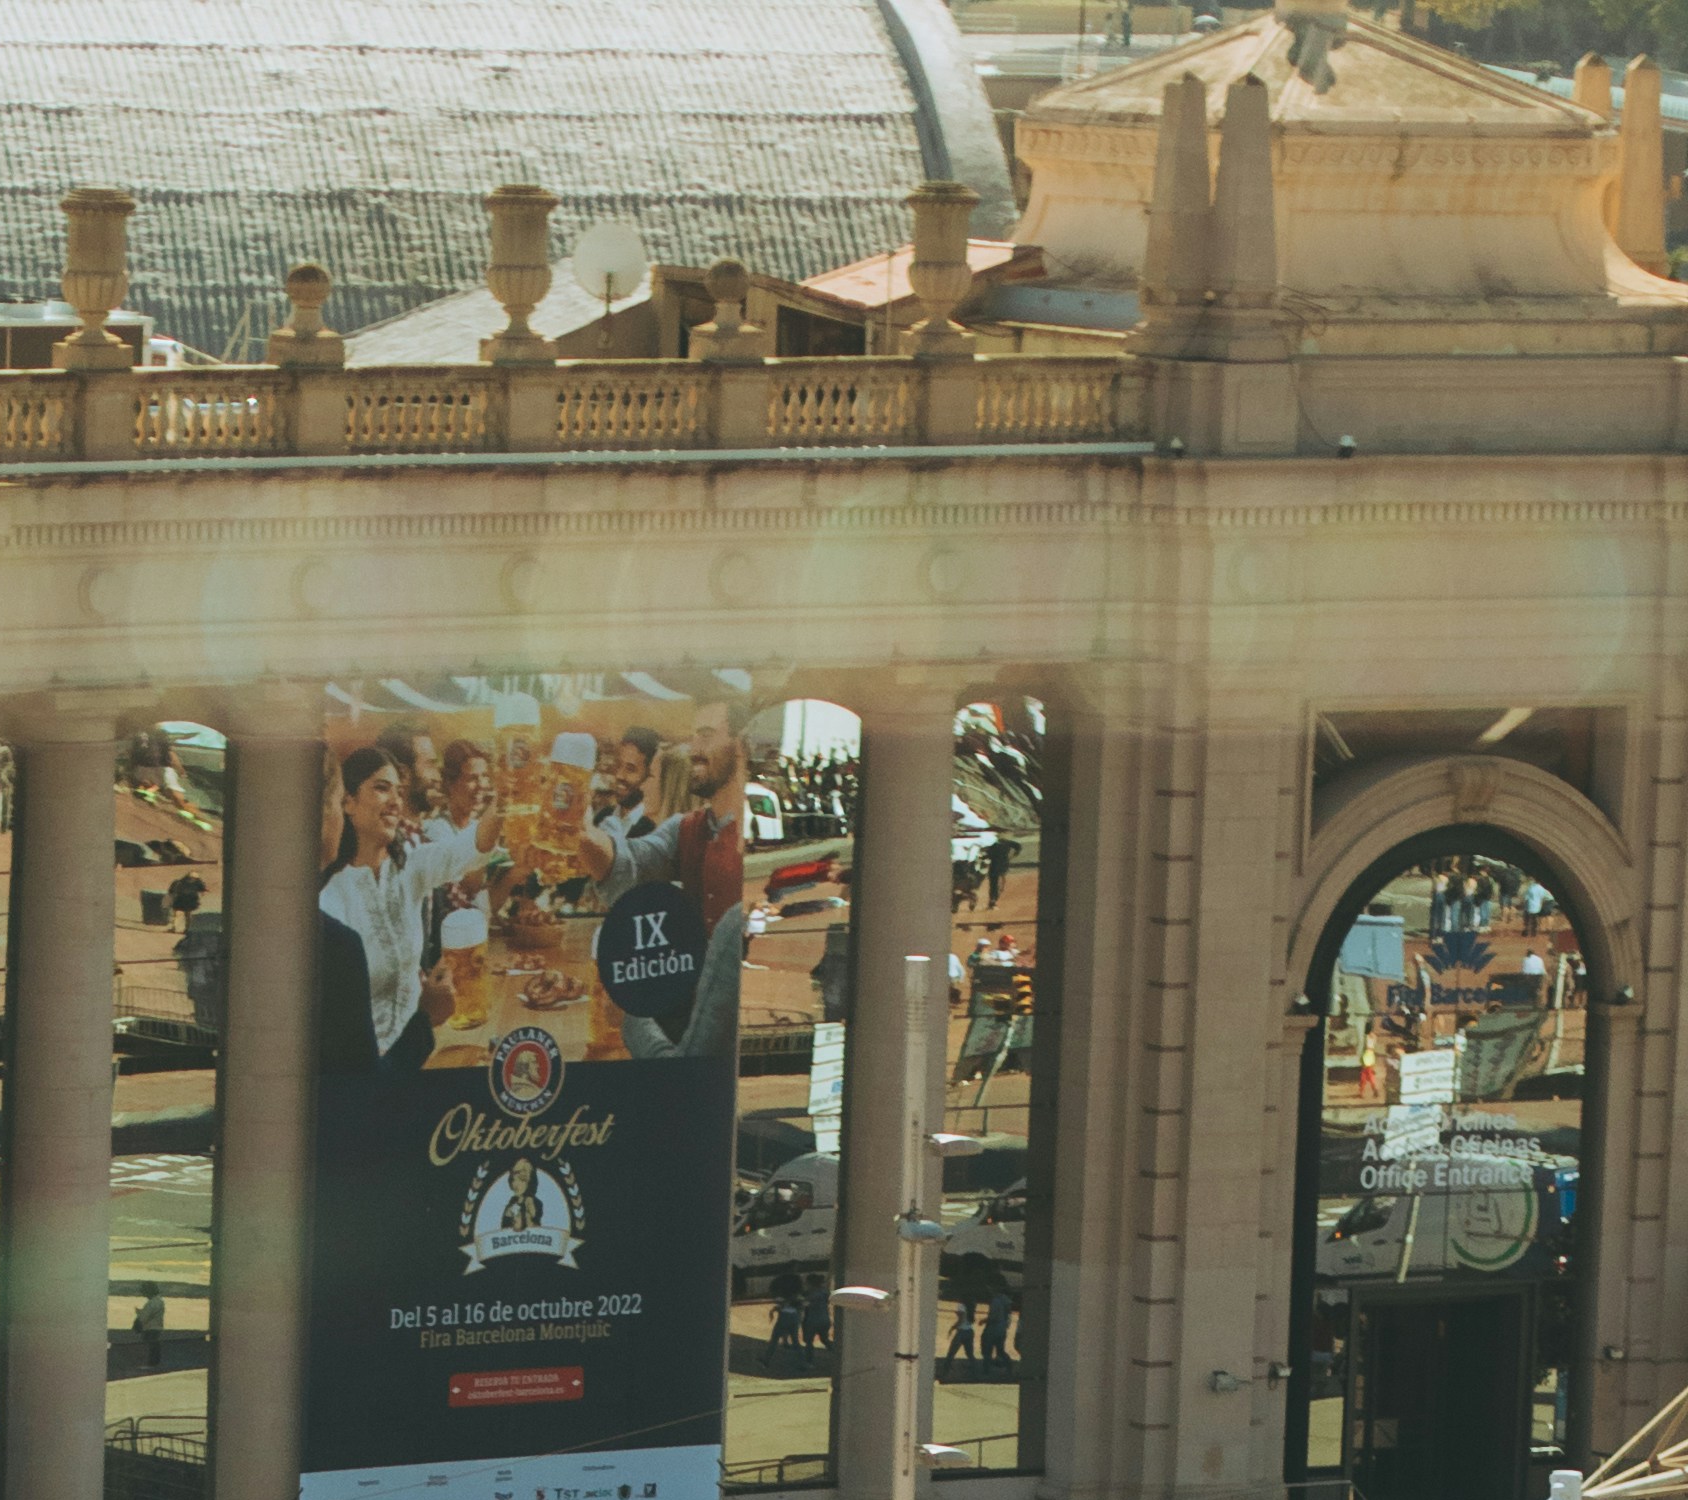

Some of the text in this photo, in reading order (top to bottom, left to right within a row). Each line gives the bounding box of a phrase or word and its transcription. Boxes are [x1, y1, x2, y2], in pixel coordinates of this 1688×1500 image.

[632, 911, 670, 950] IX
[612, 949, 695, 984] Edición
[496, 1028, 559, 1062] PAULANER
[429, 1103, 615, 1166] Oktoberfest
[1360, 1163, 1534, 1189] Office Entrance
[491, 1231, 553, 1249] Barcelona
[390, 1293, 642, 1329] Del 5 al 16 de octubre 2022
[420, 1330, 451, 1348] Fira
[455, 1326, 535, 1346] Barcelona
